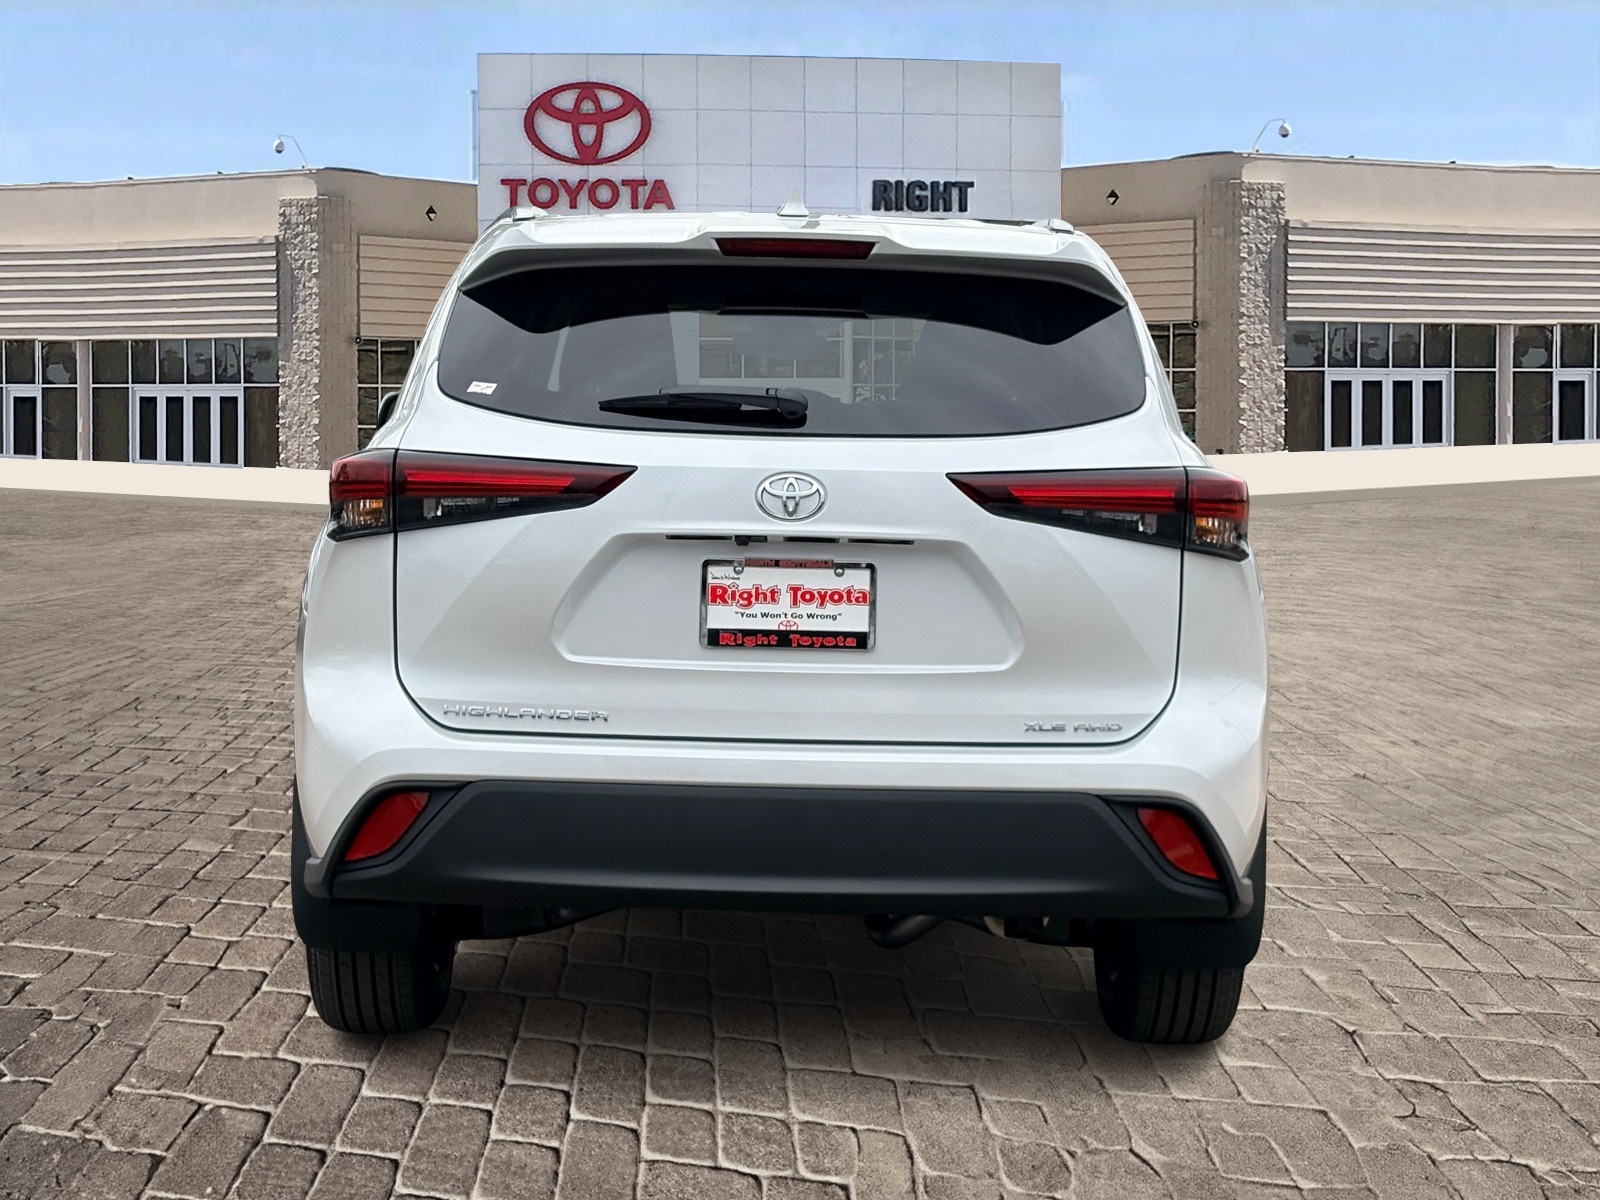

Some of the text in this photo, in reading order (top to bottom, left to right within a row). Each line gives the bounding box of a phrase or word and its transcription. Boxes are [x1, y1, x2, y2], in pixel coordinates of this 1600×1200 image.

[500, 177, 676, 210] TOYOTA
[871, 179, 975, 212] RIGHT
[708, 582, 870, 609] Right Toyota
[760, 611, 788, 619] Won't
[790, 612, 804, 620] Go
[719, 632, 857, 648] Right Toyota
[443, 703, 609, 722] HIGHLANDER
[1023, 722, 1122, 732] XLE AWD
